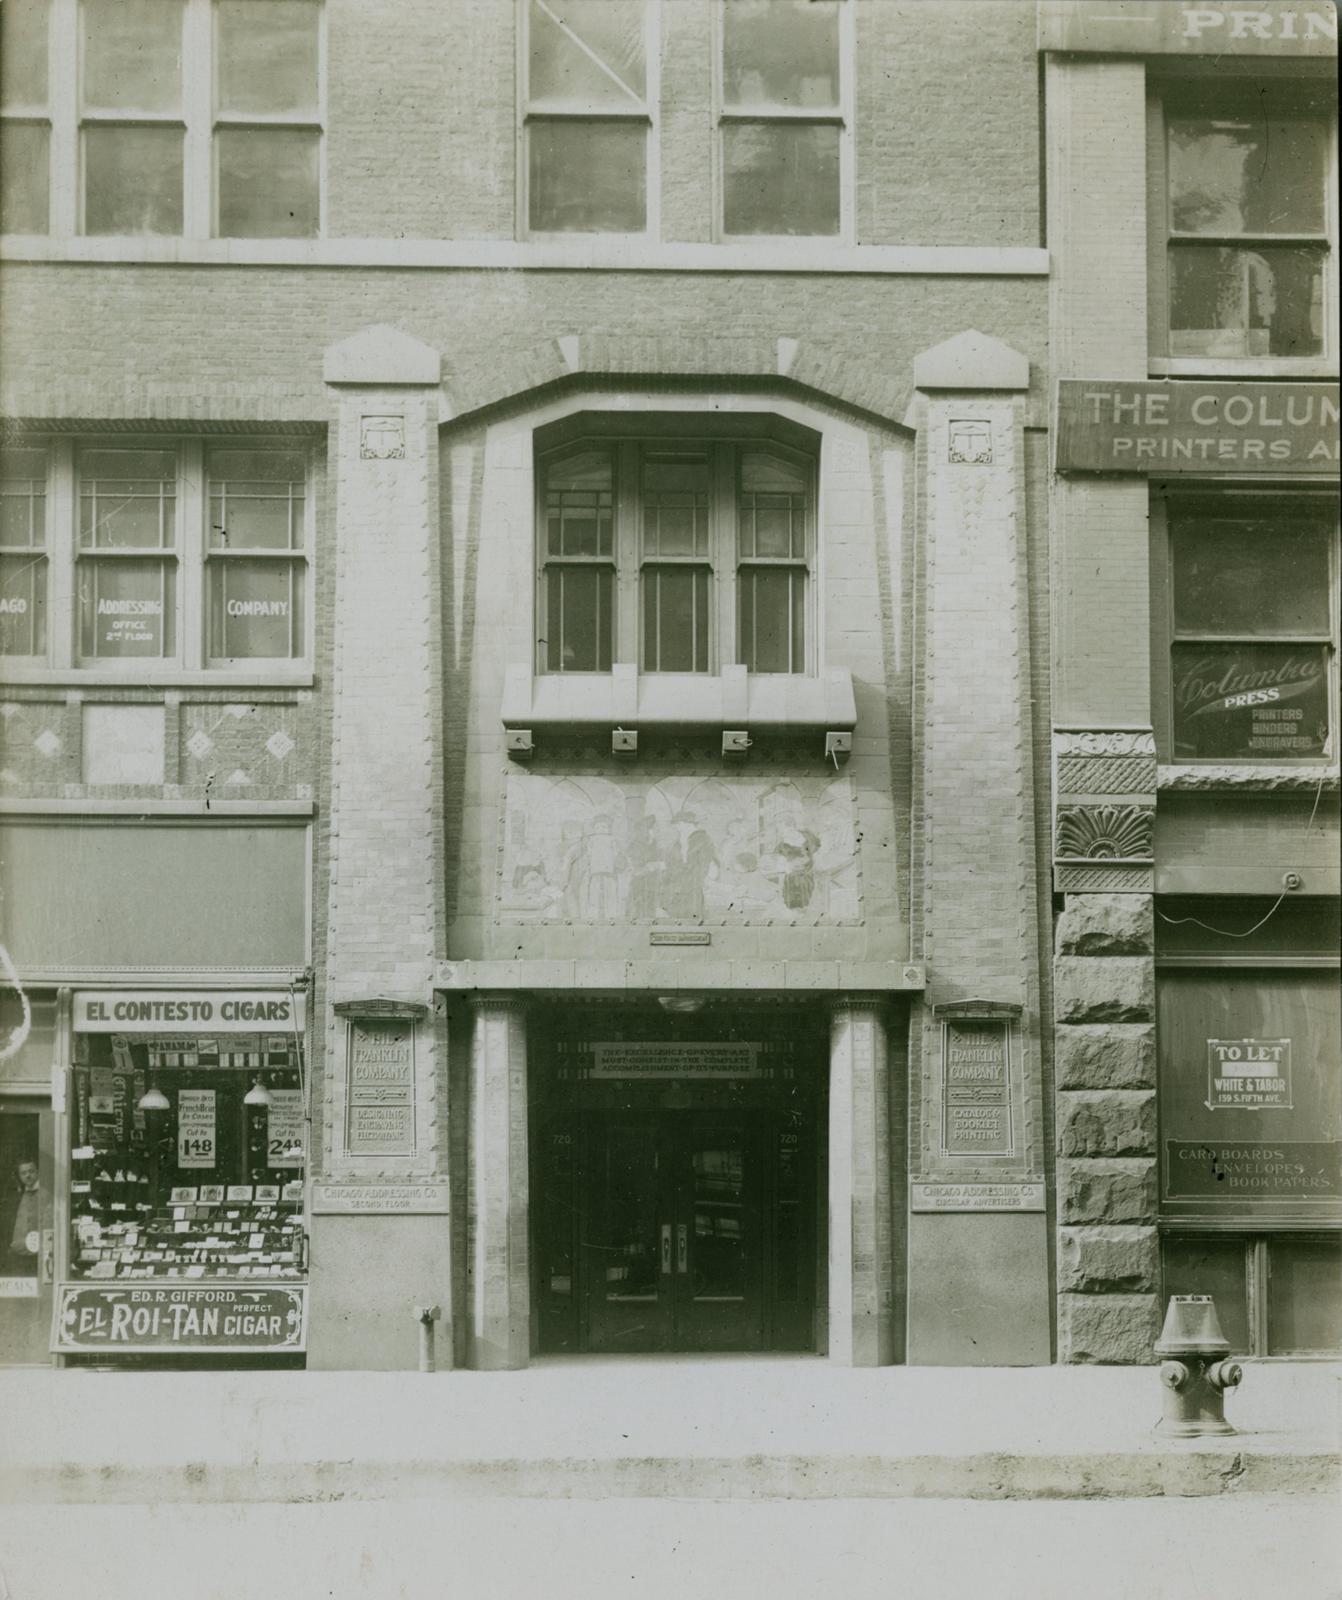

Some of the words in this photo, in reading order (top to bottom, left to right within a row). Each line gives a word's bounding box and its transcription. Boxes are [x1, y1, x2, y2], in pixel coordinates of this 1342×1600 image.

[1084, 392, 1170, 425] THE
[1112, 438, 1291, 459] PRINTERS
[0, 598, 27, 613] AGO
[98, 598, 161, 614] ADDRESSING
[112, 621, 146, 630] OFFICE
[125, 632, 153, 641] FLOOR
[1224, 688, 1280, 708] PRESS
[1252, 709, 1303, 720] PRINTERS
[1252, 723, 1298, 735] BINDERS
[1252, 736, 1313, 749] ENGRAVERS
[86, 1001, 110, 1021] EL
[113, 1001, 214, 1021] CONTESTO
[220, 1001, 290, 1021] CIGARS
[354, 1049, 409, 1063] FRANKLIN
[949, 1049, 1003, 1063] FRANKLIN
[1215, 1046, 1242, 1061] TO
[1246, 1046, 1283, 1061] LET
[354, 1066, 408, 1081] COMPANY
[949, 1066, 1003, 1081] COMPANY
[1214, 1078, 1244, 1092] WHITE
[1246, 1078, 1253, 1092] &
[1255, 1078, 1285, 1092] TABOR
[1241, 1094, 1263, 1103] FIFTH
[357, 1110, 404, 1120] DESIGNING
[954, 1120, 1000, 1130] BOOKLET
[954, 1130, 1001, 1141] PRINTING
[1179, 1150, 1217, 1160] CARD
[1221, 1149, 1285, 1160] BOARDS
[1214, 1163, 1304, 1174] ENVELOPES
[1229, 1176, 1270, 1187] BOOK
[233, 1304, 273, 1313] PERFECT
[79, 1307, 107, 1335] EL
[110, 1303, 220, 1341] ROI-TAN
[224, 1315, 282, 1336] CIGAR
